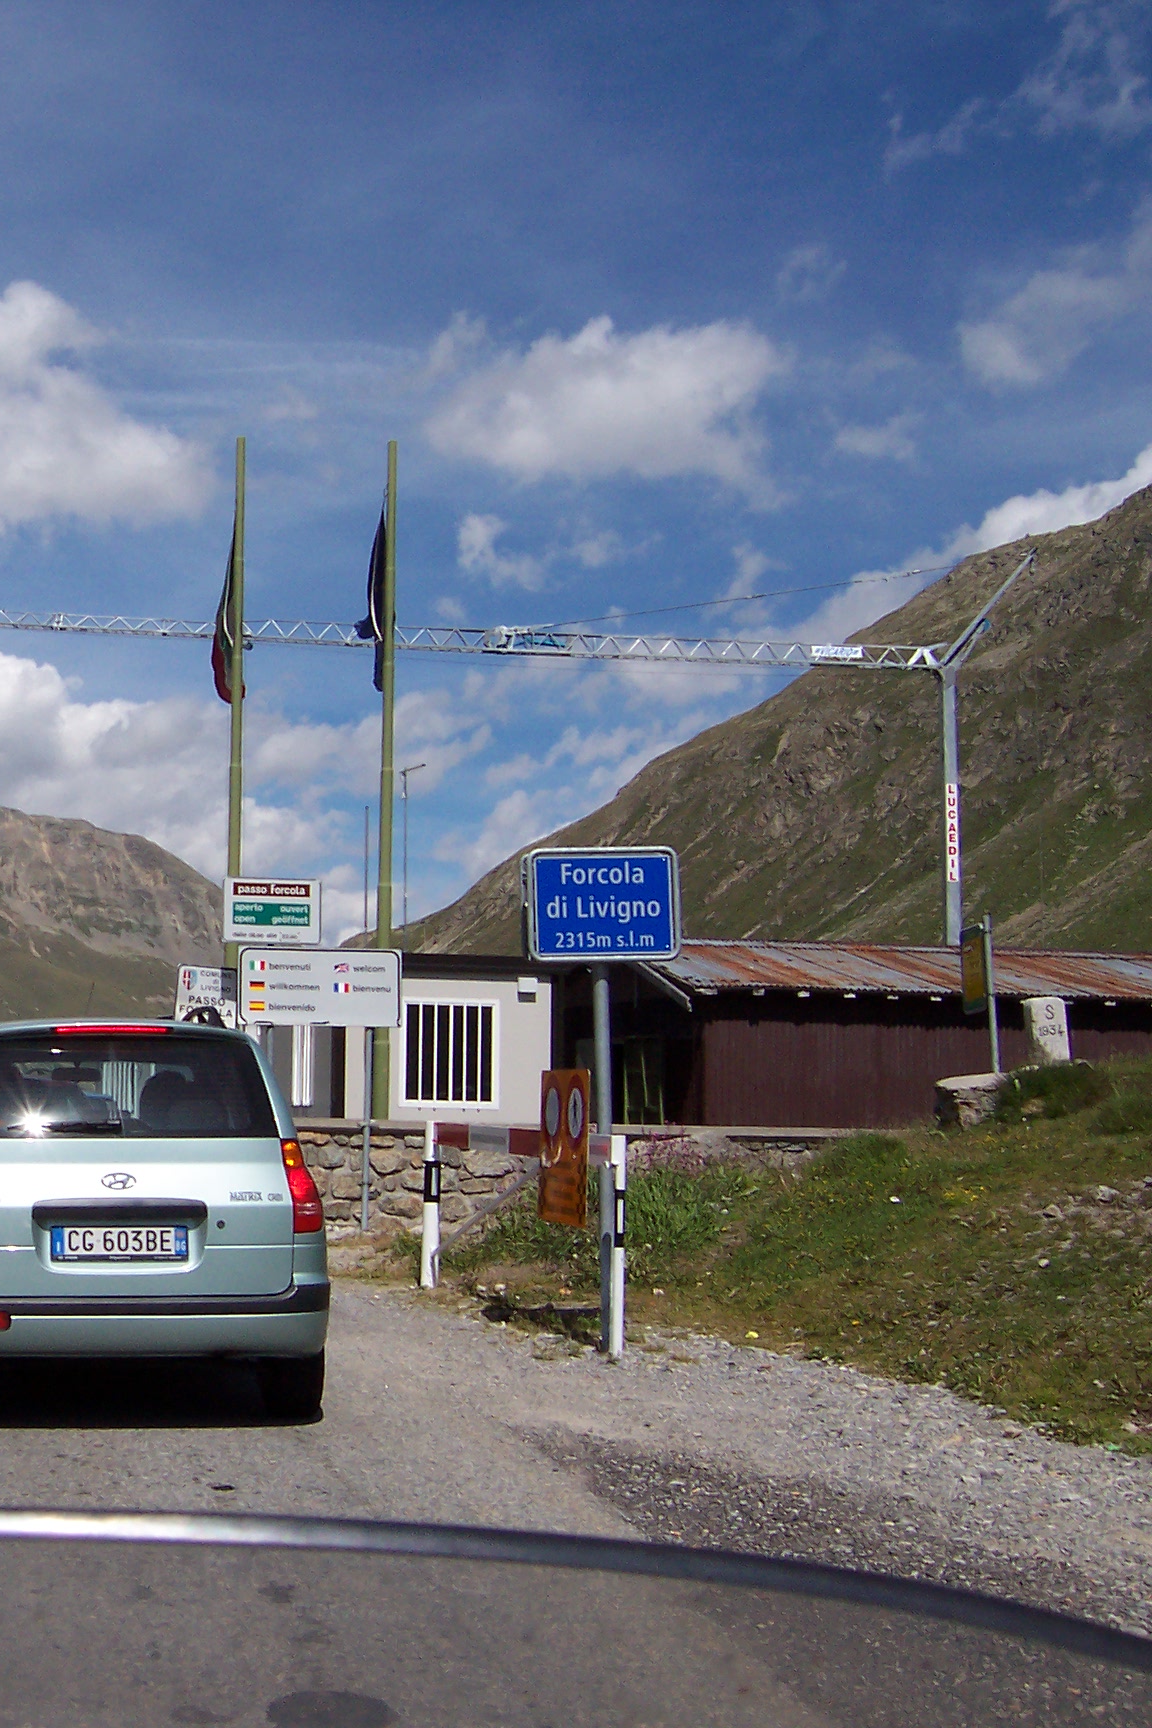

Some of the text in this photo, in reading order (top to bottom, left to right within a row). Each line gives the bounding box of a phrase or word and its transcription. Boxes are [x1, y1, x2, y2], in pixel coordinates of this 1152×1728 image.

[947, 784, 957, 881] LUCAEDIL
[560, 861, 645, 885] Forcola
[237, 883, 306, 896] passo forcola
[234, 902, 264, 913] aperto
[279, 905, 309, 914] ouvert
[546, 895, 661, 923] di Livigno
[234, 915, 257, 924] open
[271, 914, 309, 925] geöffnet
[555, 930, 655, 948] 2315m s.l.m
[268, 962, 312, 971] benvenuti
[352, 965, 387, 973] welcom
[268, 981, 321, 991] willkommen
[352, 984, 392, 993] bienvenu
[189, 995, 226, 1006] PASSO
[179, 1004, 233, 1019] FOLA
[268, 1003, 316, 1012] bienvenido
[1045, 1004, 1055, 1020] S
[67, 1230, 94, 1252] CG
[102, 1230, 172, 1252] 603BE
